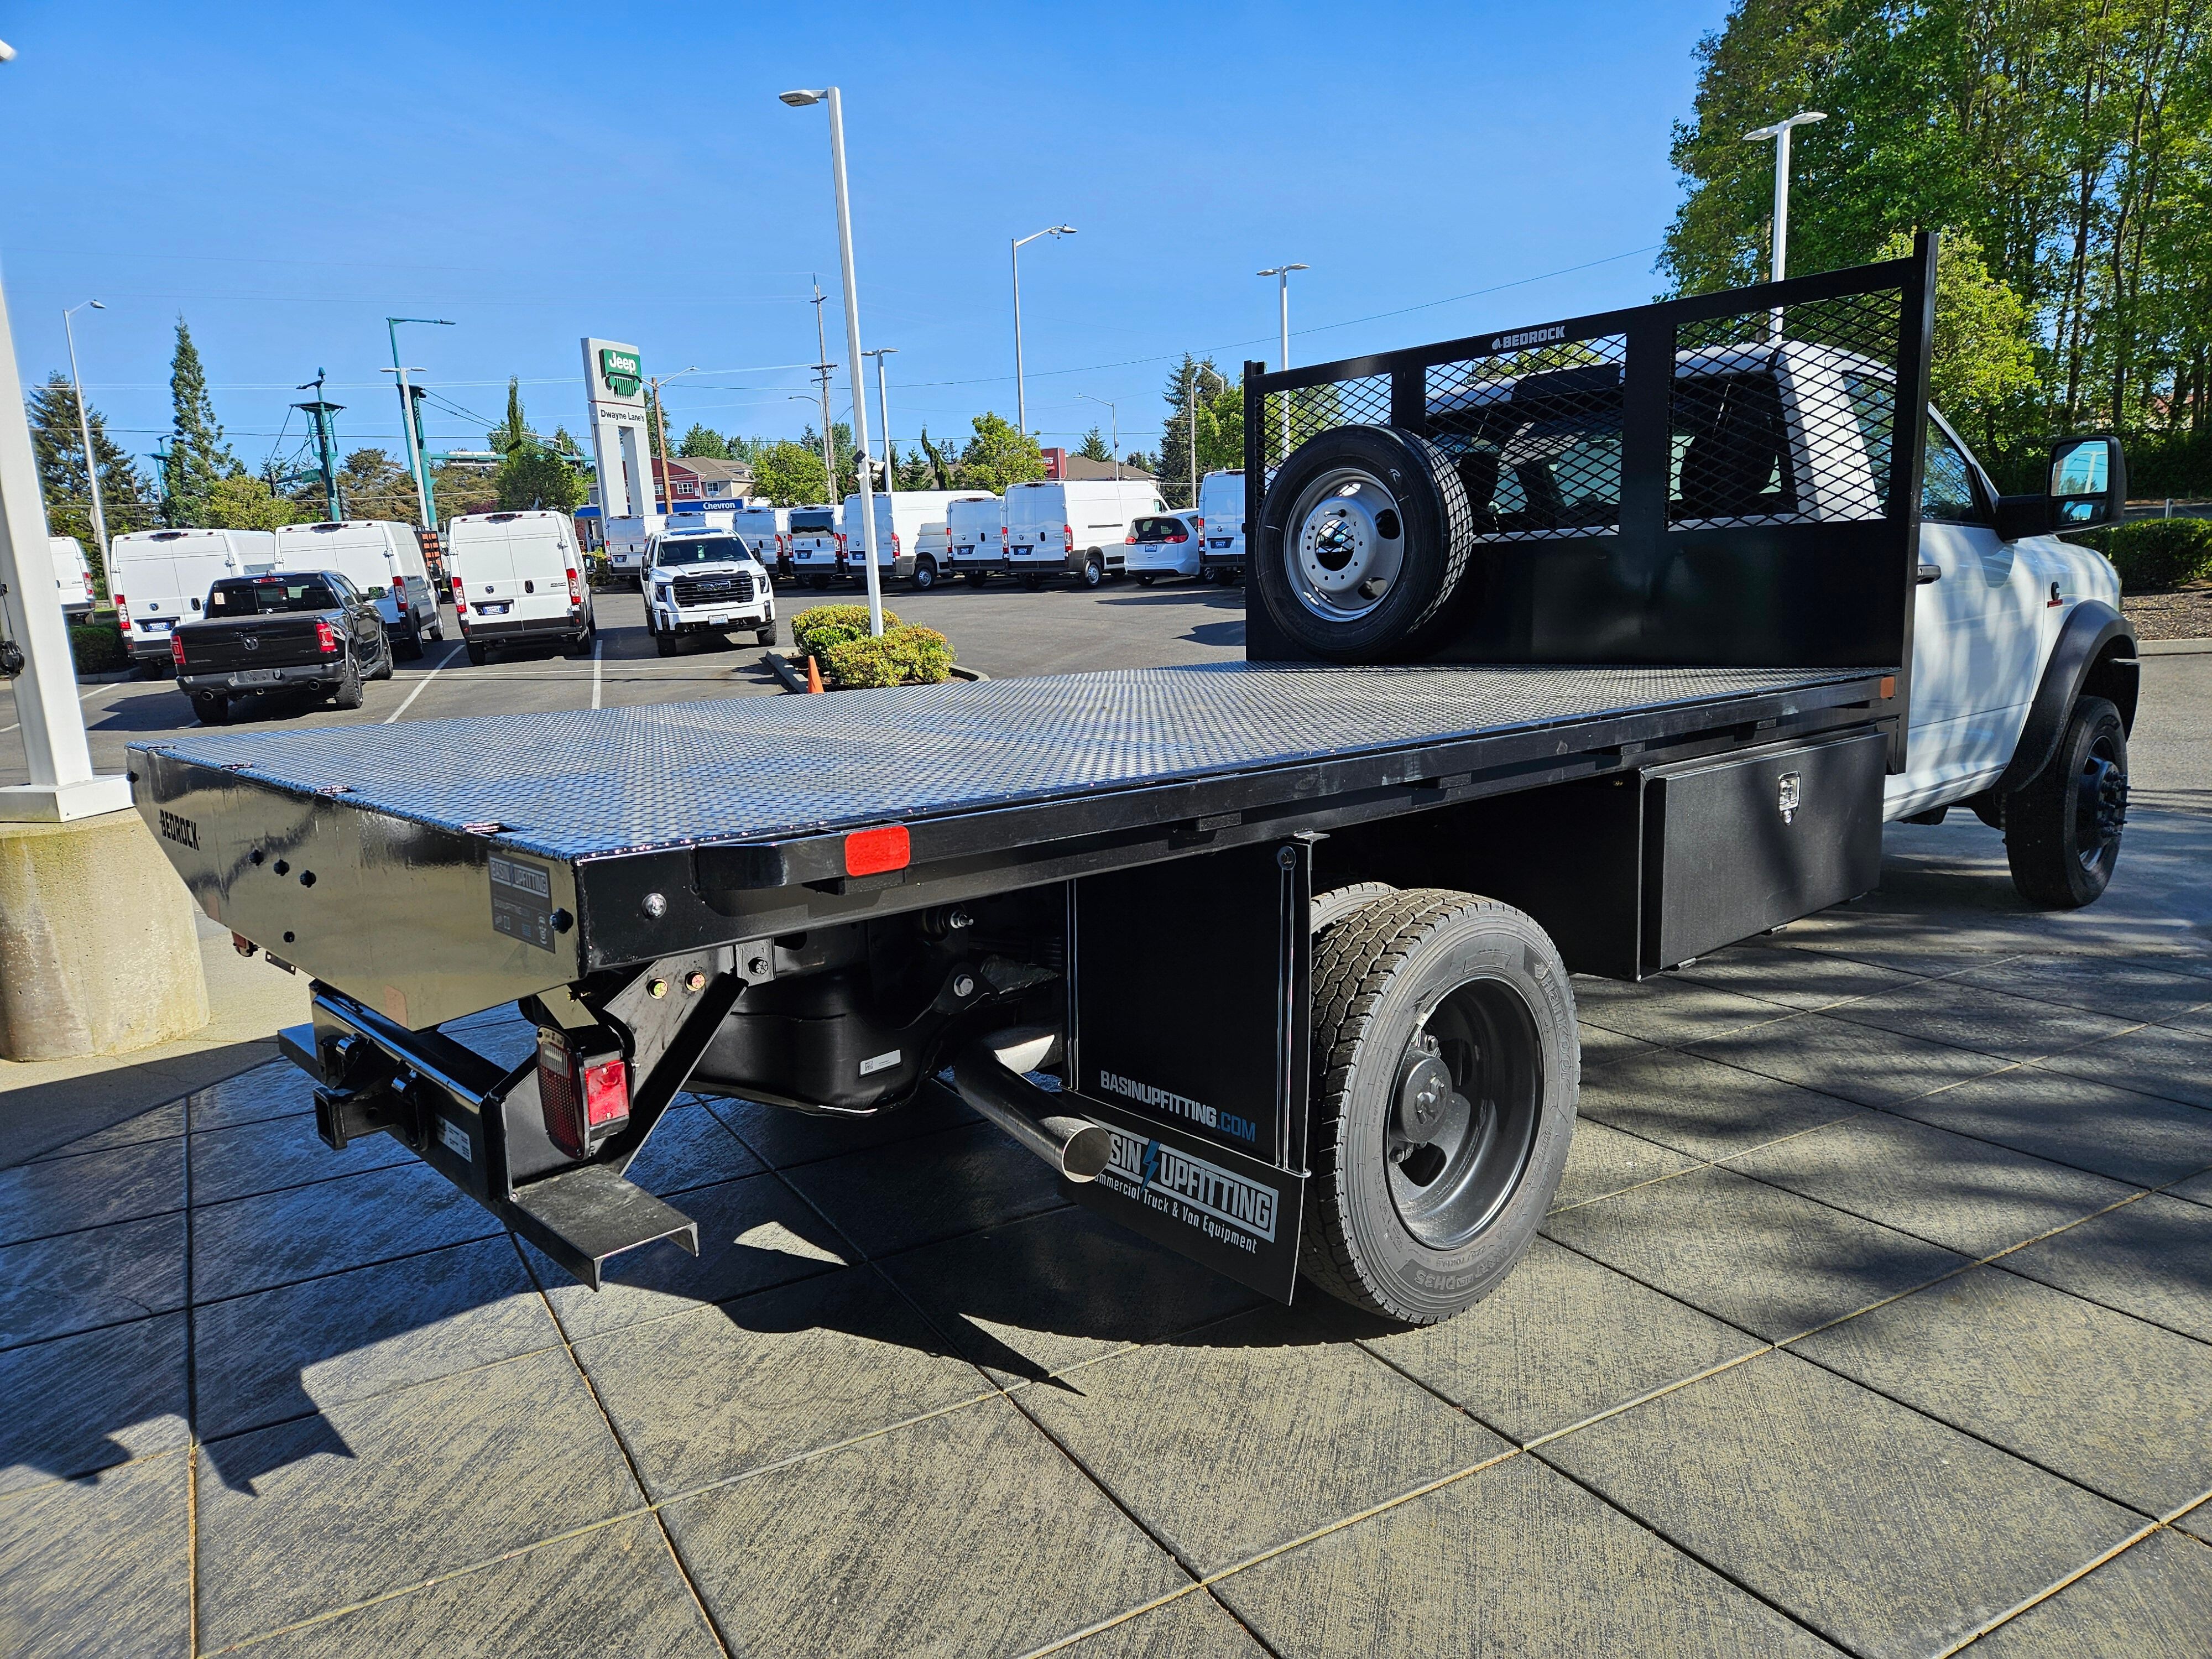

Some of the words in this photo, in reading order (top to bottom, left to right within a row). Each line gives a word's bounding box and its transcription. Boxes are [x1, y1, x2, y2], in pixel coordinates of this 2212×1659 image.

[1503, 325, 1566, 348] BEDROCK
[609, 352, 636, 374] Jeep
[601, 409, 627, 421] Dwayne
[628, 412, 645, 422] Lane's
[703, 502, 736, 510] Chevron
[159, 809, 200, 851] BEDROCK
[491, 861, 510, 881] BASIN
[514, 868, 546, 893] UPFITTING
[1100, 1070, 1256, 1142] BASINUPFITTING.COM
[1109, 1134, 1142, 1175] SIN
[1160, 1152, 1271, 1229] UPFITTING
[1094, 1173, 1140, 1201] ommercial
[1144, 1188, 1168, 1214] Truck
[1172, 1201, 1178, 1218] &
[1182, 1206, 1199, 1228] Van
[1202, 1214, 1258, 1254] Equipment
